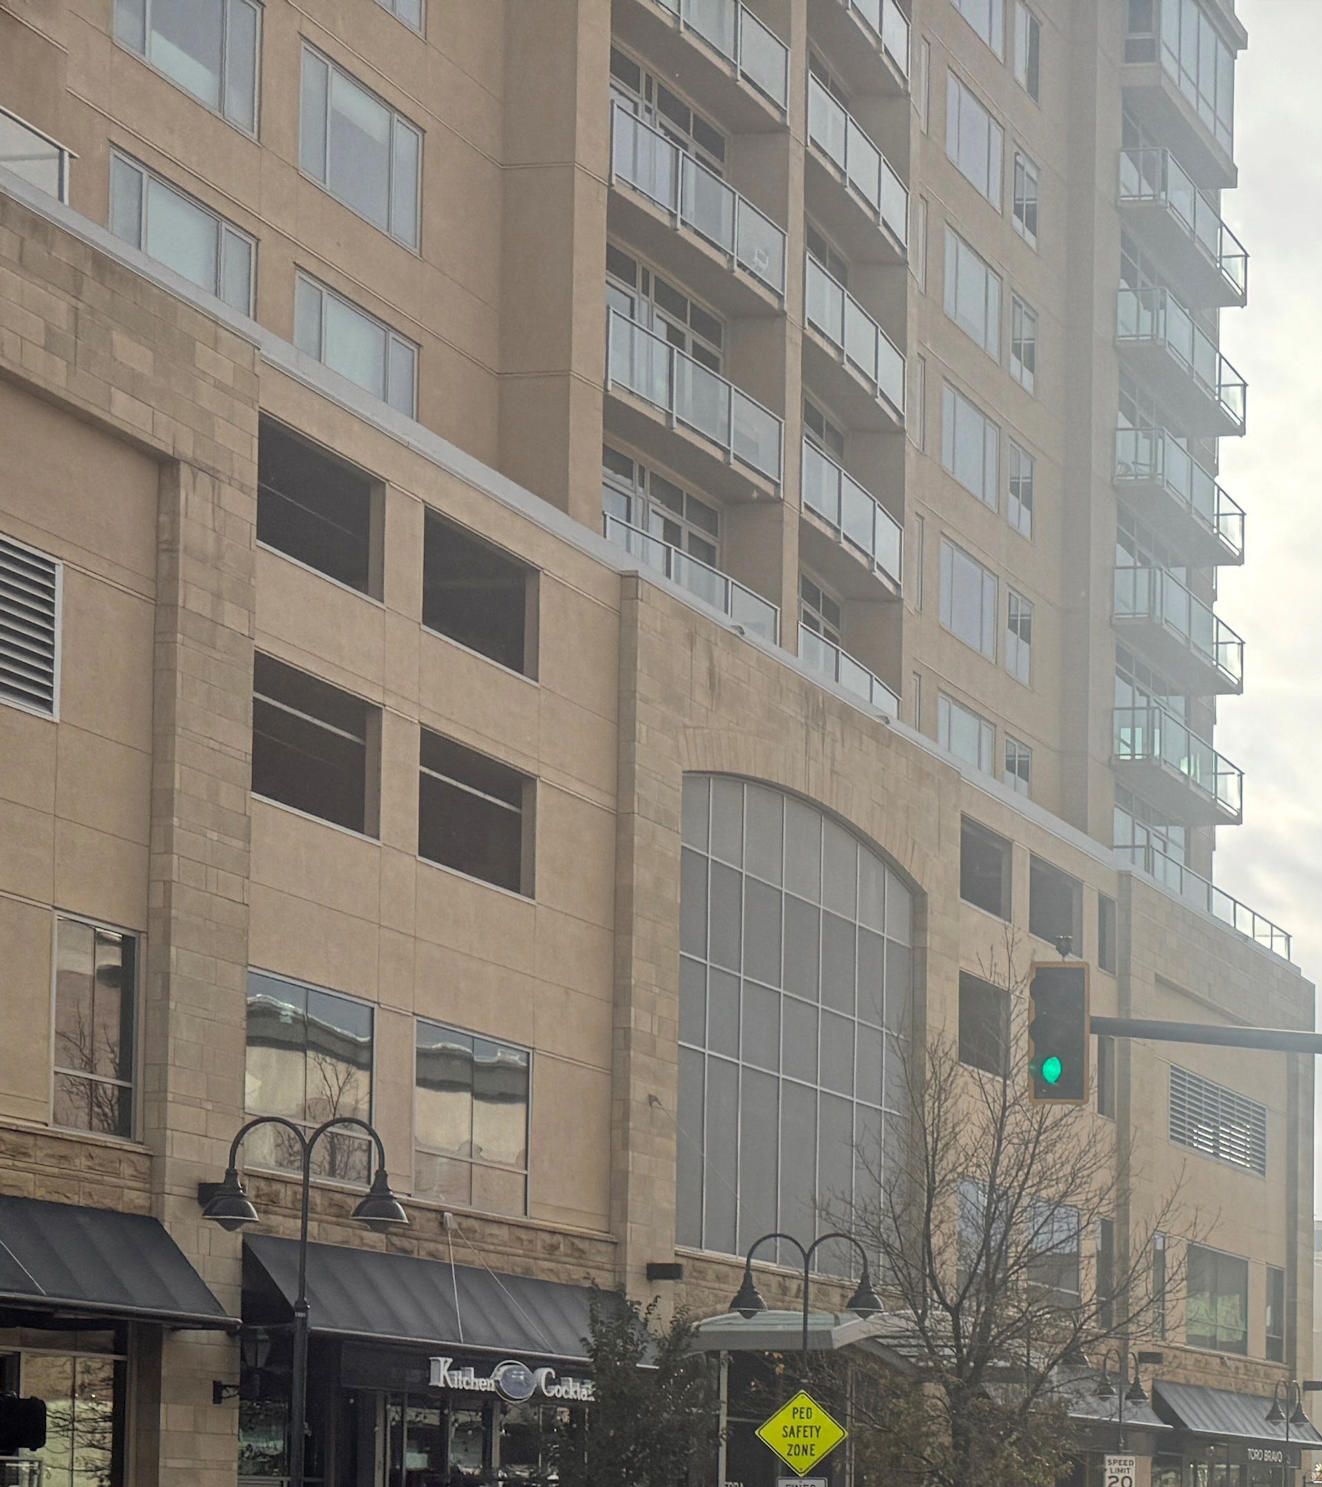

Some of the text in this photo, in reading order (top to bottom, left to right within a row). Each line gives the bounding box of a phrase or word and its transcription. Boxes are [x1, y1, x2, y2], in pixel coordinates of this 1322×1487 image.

[428, 1356, 596, 1401] Kitchen Cockta
[792, 1406, 813, 1420] PED
[782, 1425, 822, 1439] SAFETY
[786, 1444, 816, 1457] ZONE
[1107, 1459, 1135, 1467] SPEED
